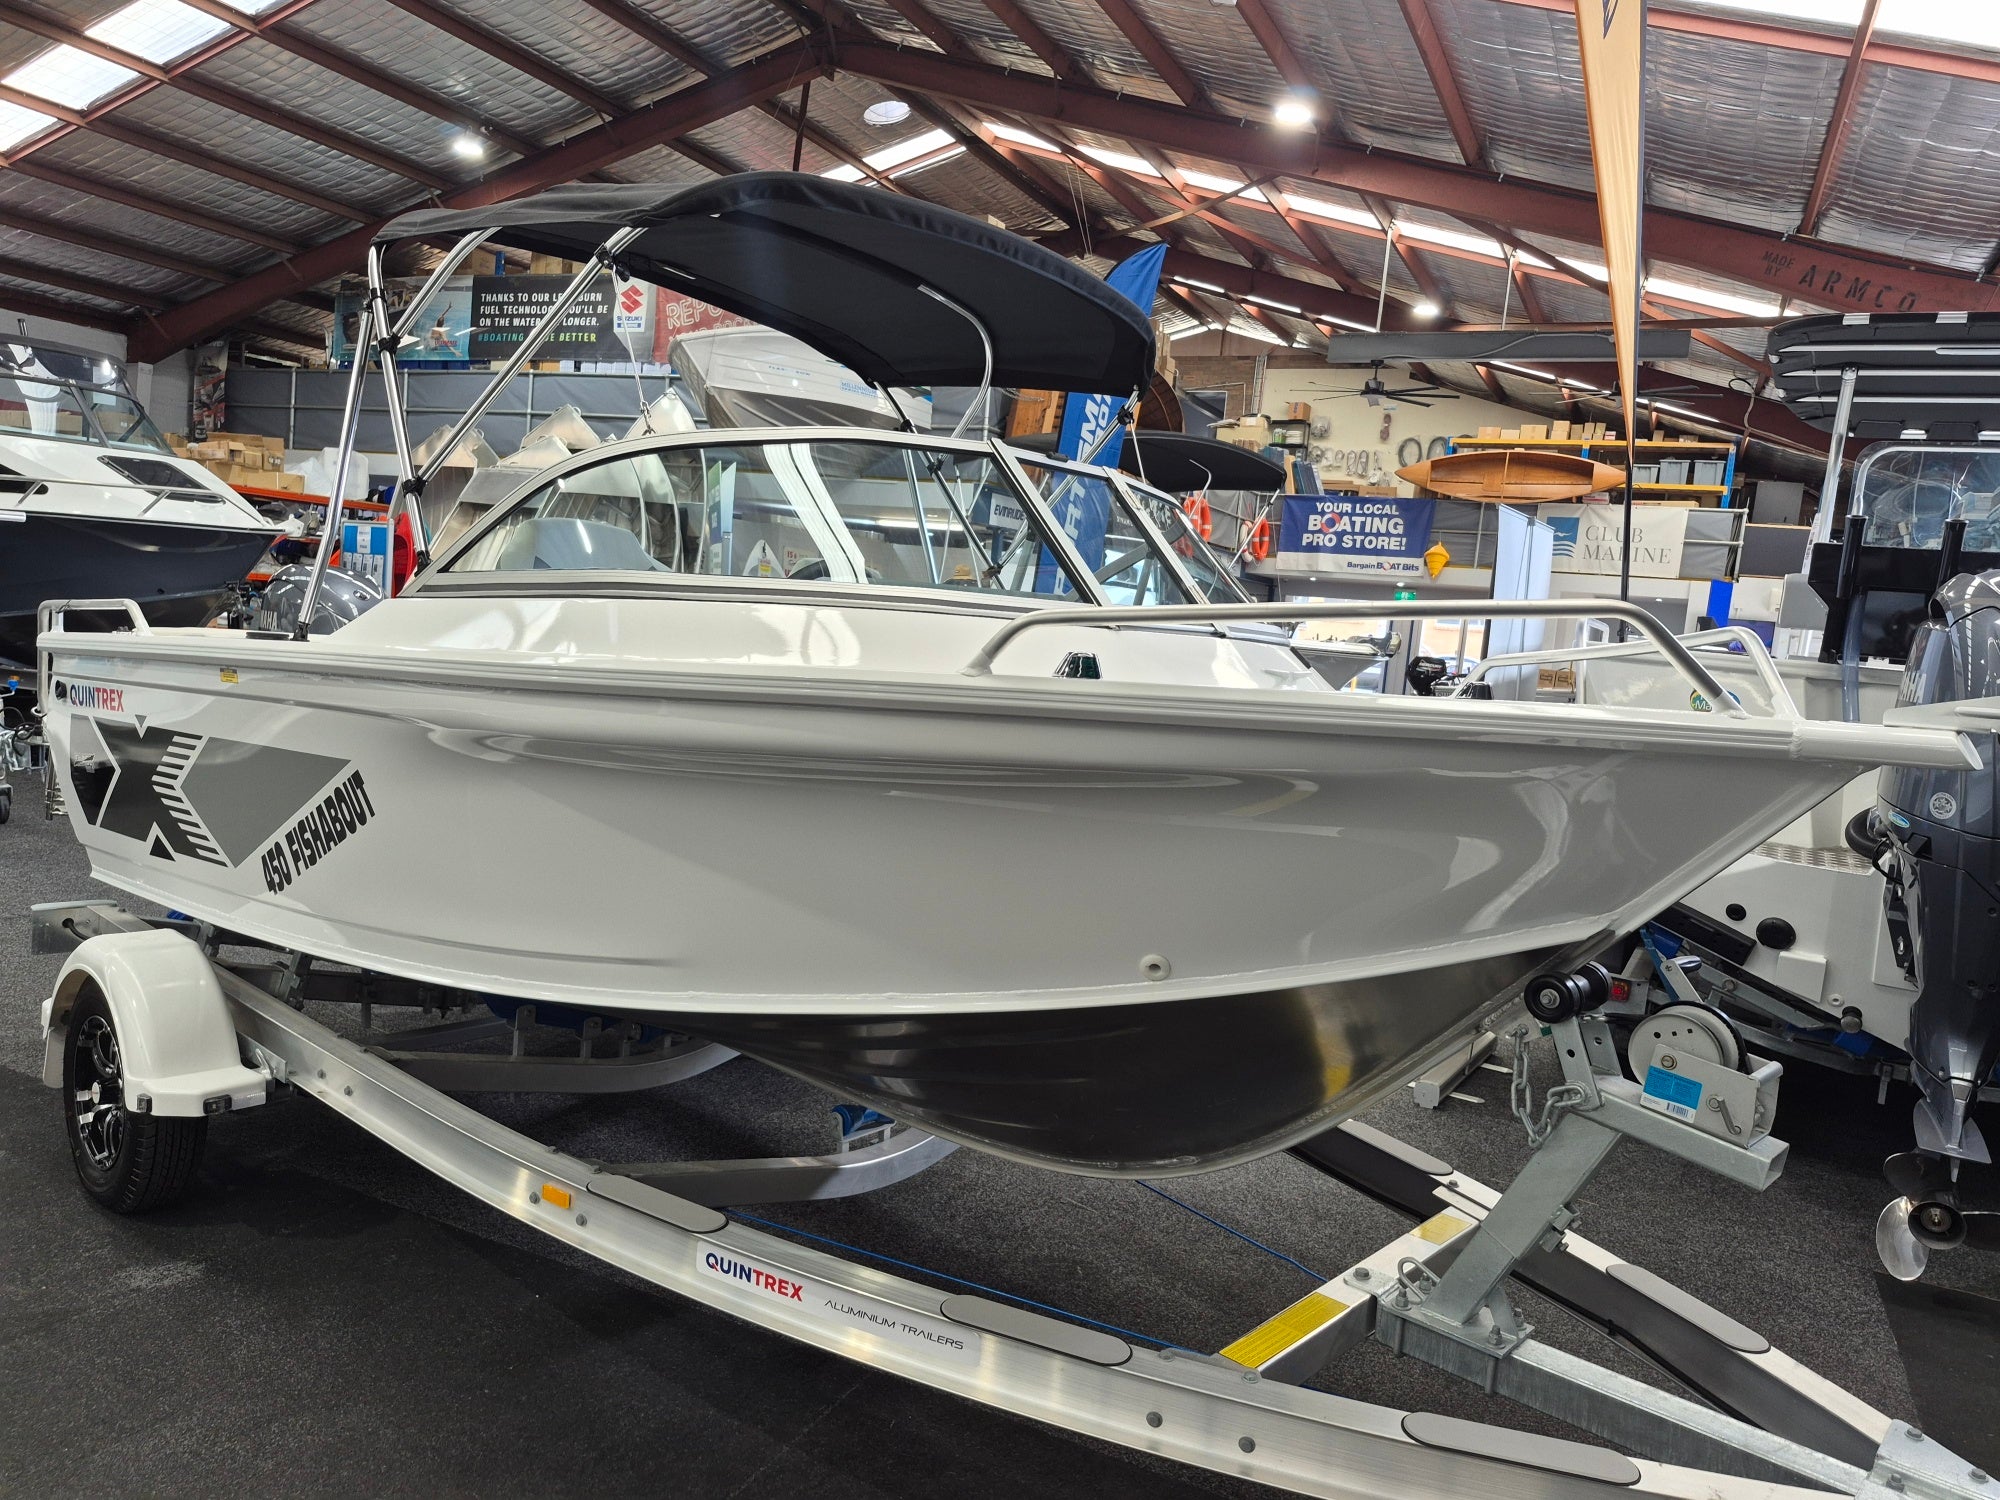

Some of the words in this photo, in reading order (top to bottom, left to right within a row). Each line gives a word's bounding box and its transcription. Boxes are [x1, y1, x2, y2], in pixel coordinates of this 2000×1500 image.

[1762, 251, 1796, 270] MADE
[1764, 266, 1782, 277] BY
[1798, 264, 1919, 312] ARMCO
[480, 293, 514, 302] THANKS
[517, 293, 529, 302] TO
[531, 293, 550, 302] OUR
[578, 292, 603, 302] BURN
[480, 305, 500, 315] FUEL
[567, 304, 594, 314] OU'LL
[597, 304, 609, 314] BE
[479, 317, 492, 327] ON
[494, 317, 511, 327] THE
[562, 316, 600, 327] LONGER.
[478, 332, 525, 342] #BOATING
[559, 332, 597, 342] BETTER
[1316, 502, 1353, 513] YOUR
[1355, 503, 1400, 515] LOCAL
[1307, 512, 1405, 535] BOATING
[1302, 533, 1337, 547] PRO
[1341, 534, 1407, 551] STORE!
[1347, 561, 1376, 571] Bargain
[1376, 561, 1402, 571] BOAT
[1402, 563, 1420, 571] Bits
[69, 683, 125, 713] QUINTREX
[260, 841, 293, 895] 450
[286, 769, 376, 877] FISHABOUT
[705, 1252, 804, 1303] QUINTREX
[824, 1299, 896, 1329] ALUMINIUM
[901, 1323, 964, 1350] TRAILERS
